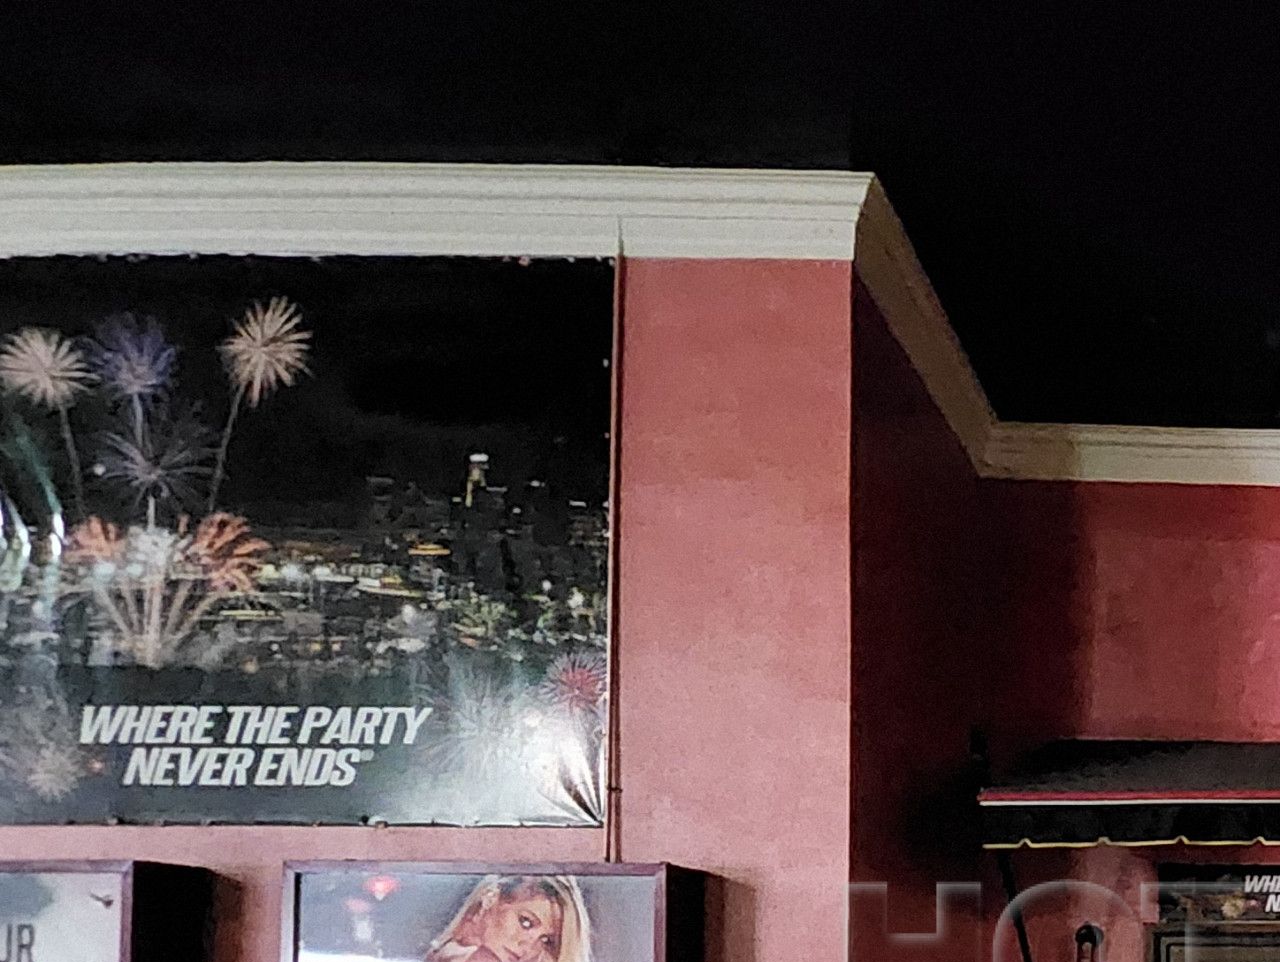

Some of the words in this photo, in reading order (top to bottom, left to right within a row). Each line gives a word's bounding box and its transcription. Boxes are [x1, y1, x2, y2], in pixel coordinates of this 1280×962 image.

[79, 704, 221, 745] WHERE
[226, 705, 300, 745] THE
[299, 706, 434, 746] PARTY
[123, 747, 253, 786] NEVER
